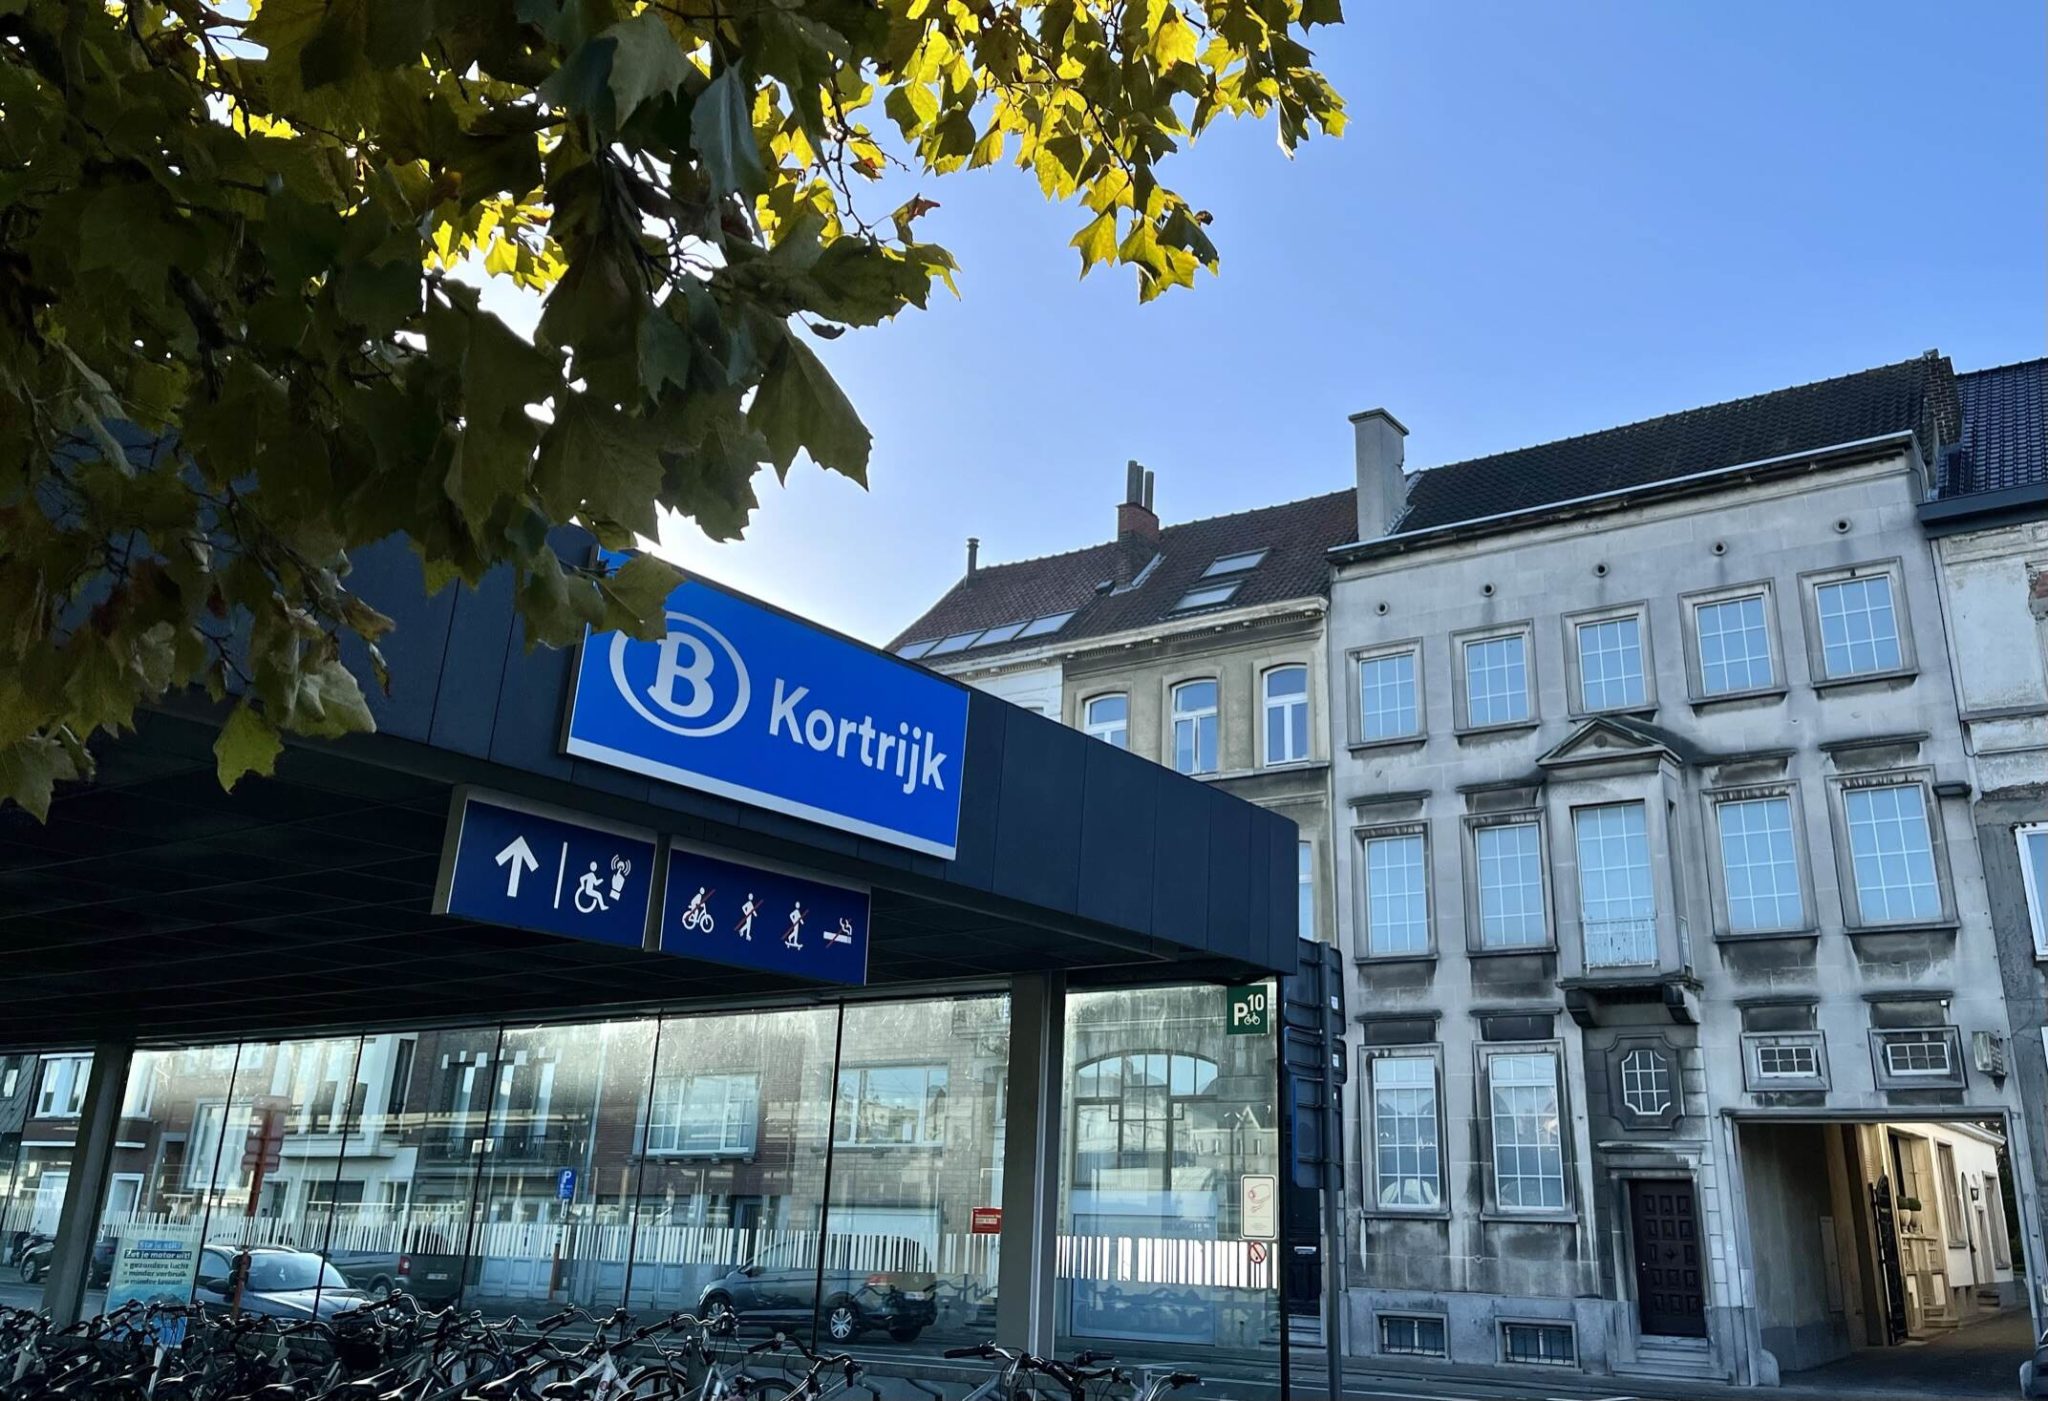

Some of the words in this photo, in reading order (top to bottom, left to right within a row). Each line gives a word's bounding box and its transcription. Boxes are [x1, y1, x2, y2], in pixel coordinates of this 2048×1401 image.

[646, 631, 715, 718] B
[769, 678, 947, 795] Kortrijk
[1247, 994, 1264, 1011] 10
[1234, 1003, 1248, 1026] P
[562, 1171, 572, 1183] P
[125, 1249, 139, 1259] Zet
[150, 1251, 176, 1259] motor
[170, 1262, 189, 1270] lucht
